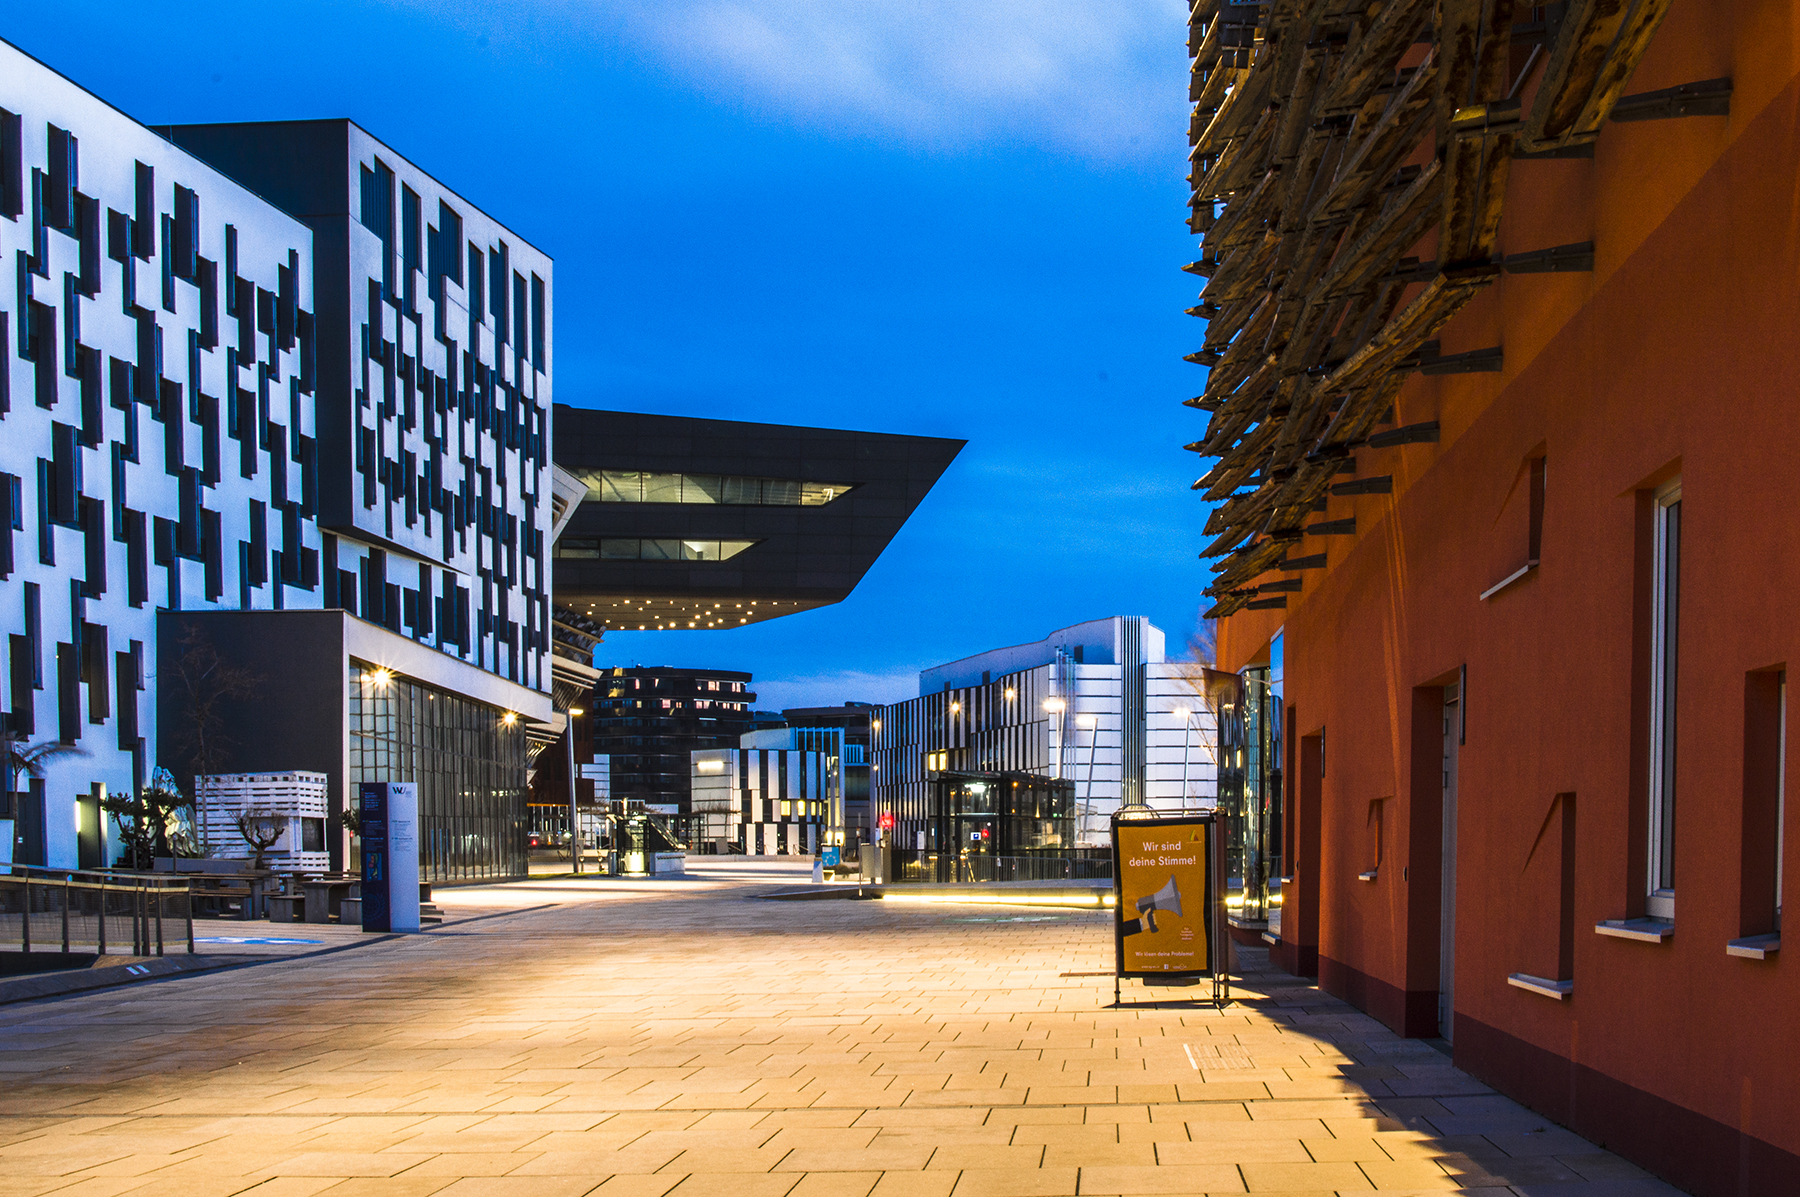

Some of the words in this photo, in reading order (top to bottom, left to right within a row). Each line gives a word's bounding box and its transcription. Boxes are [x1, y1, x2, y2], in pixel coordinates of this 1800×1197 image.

[392, 786, 406, 795] WU
[1142, 841, 1159, 852] Wir
[1161, 841, 1181, 851] sind
[1129, 857, 1155, 867] deine
[1158, 856, 1196, 866] Stimme!
